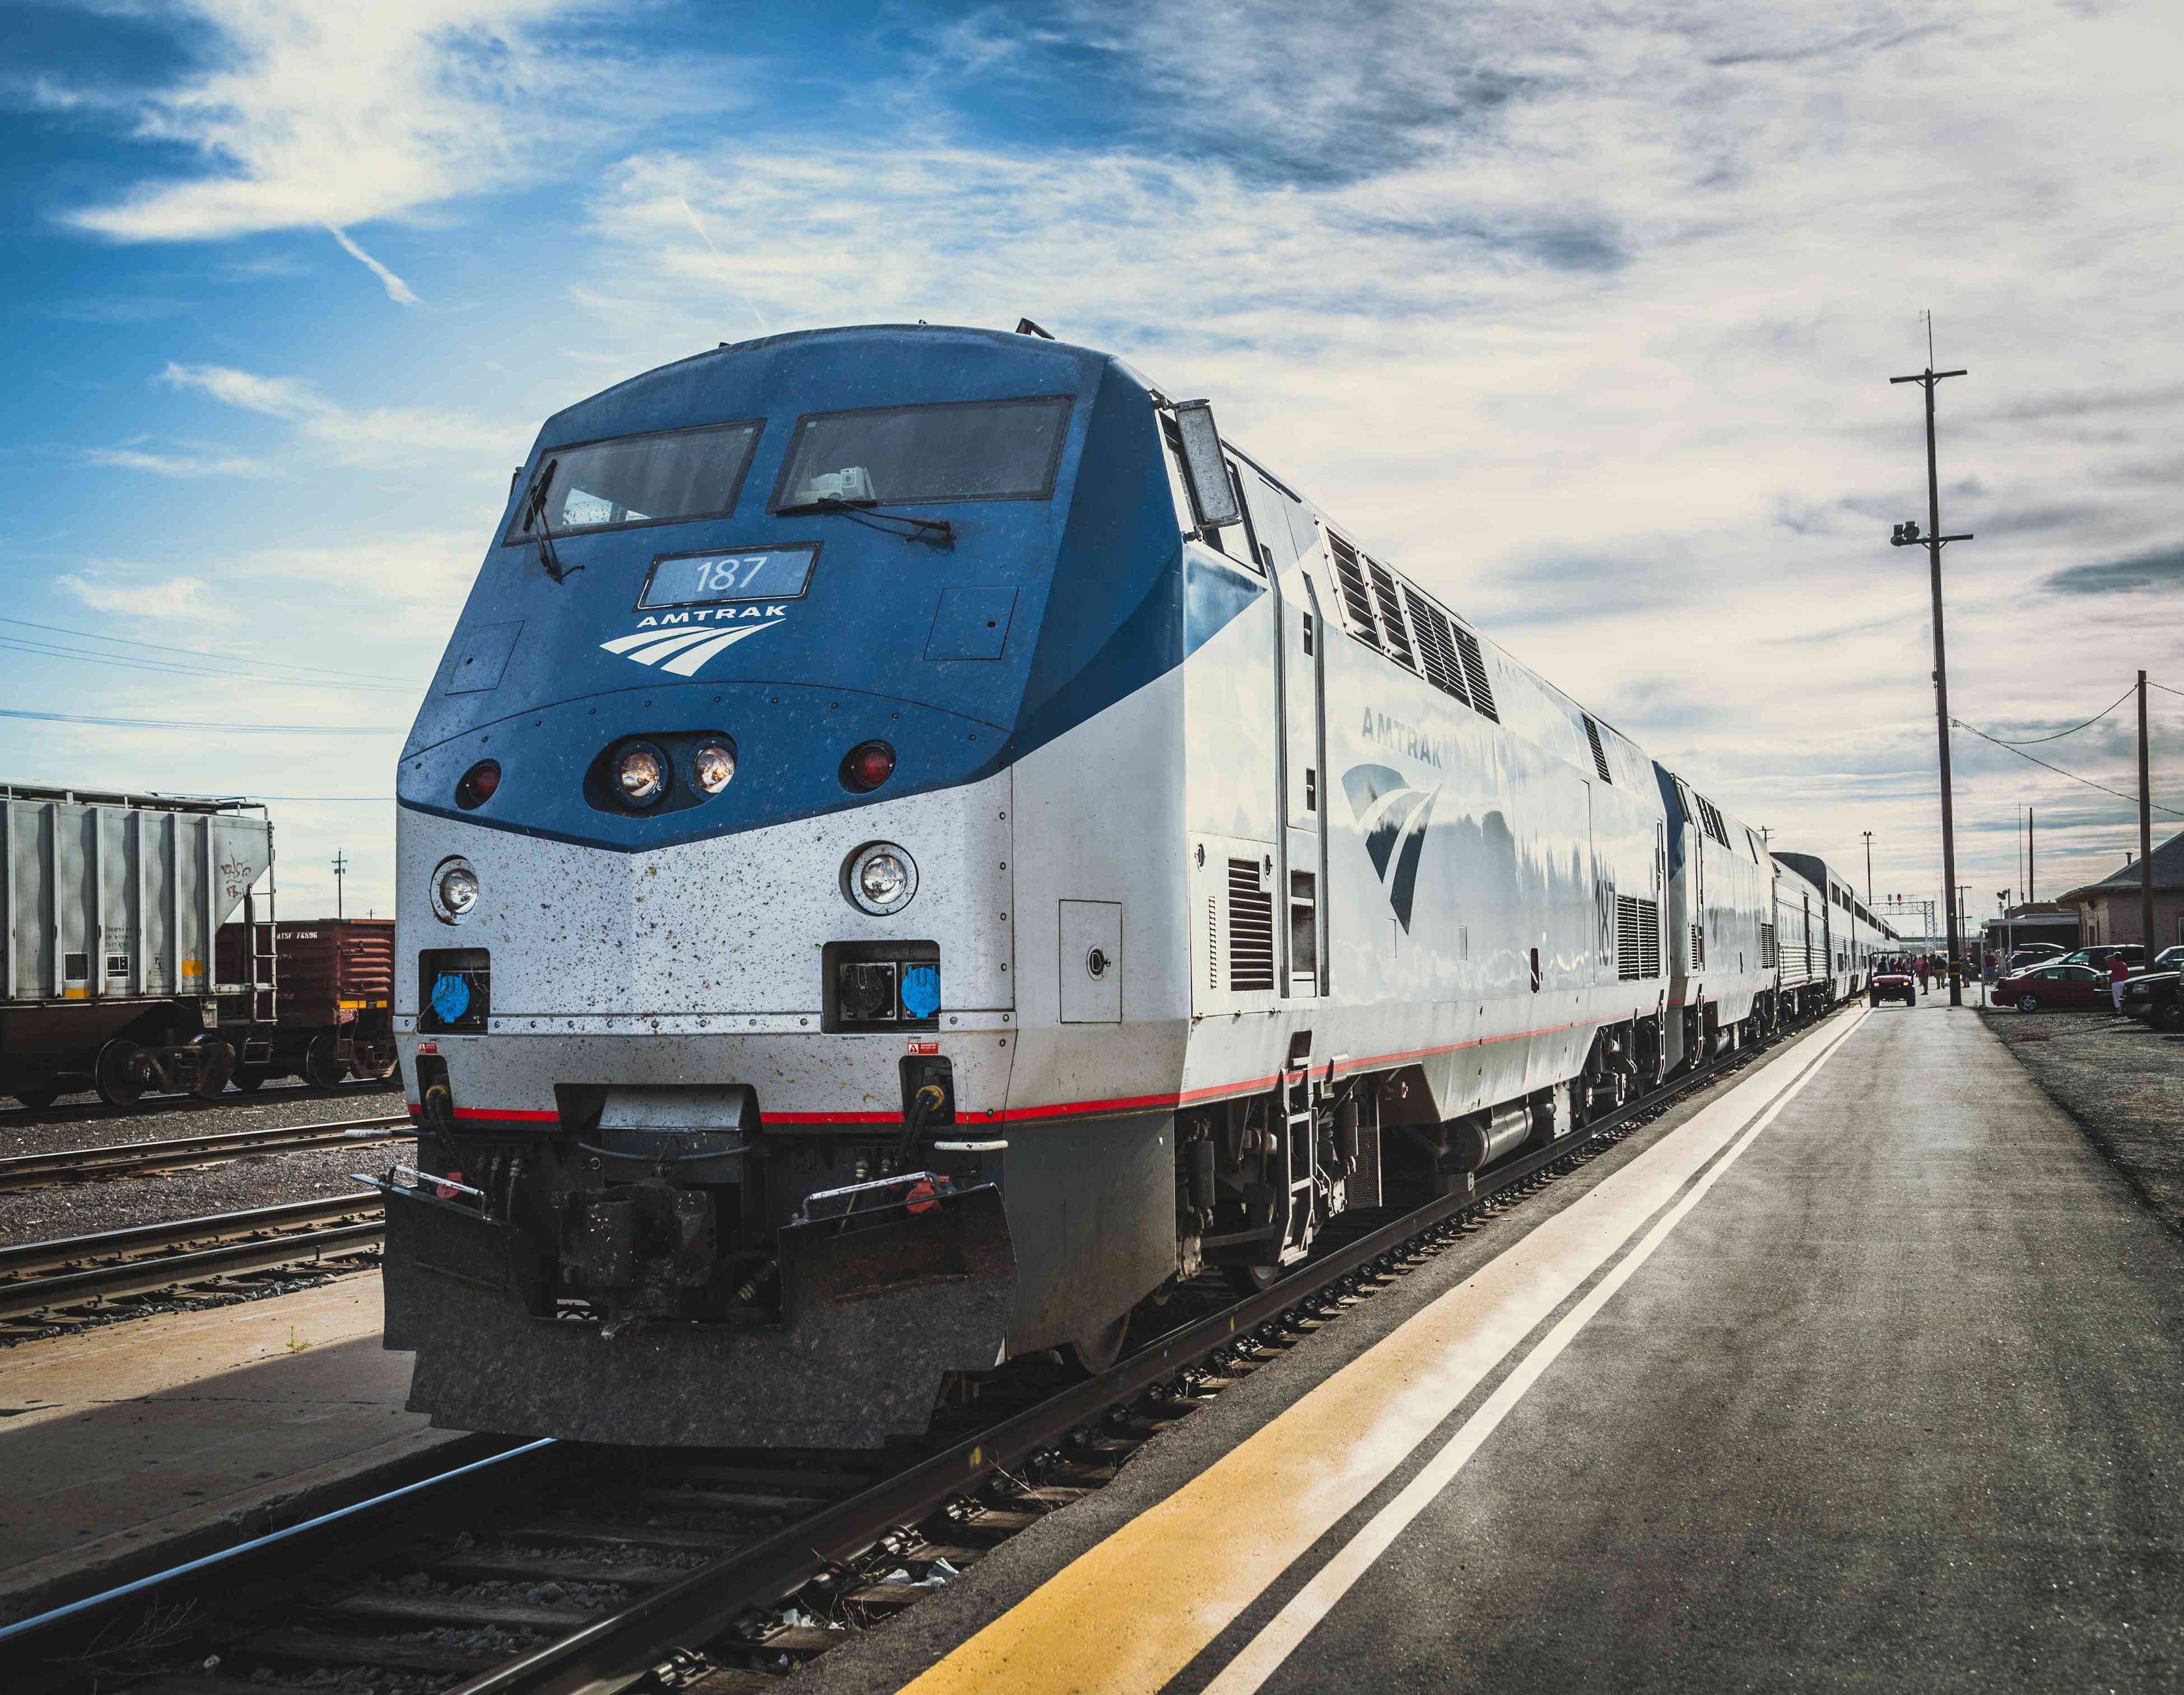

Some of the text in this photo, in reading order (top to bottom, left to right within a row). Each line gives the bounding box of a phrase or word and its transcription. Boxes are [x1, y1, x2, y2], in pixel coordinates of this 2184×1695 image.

[697, 556, 767, 592] 187
[636, 606, 788, 628] AMTRAK
[1362, 706, 1442, 770] AMTRAK
[1595, 879, 1615, 966] 187
